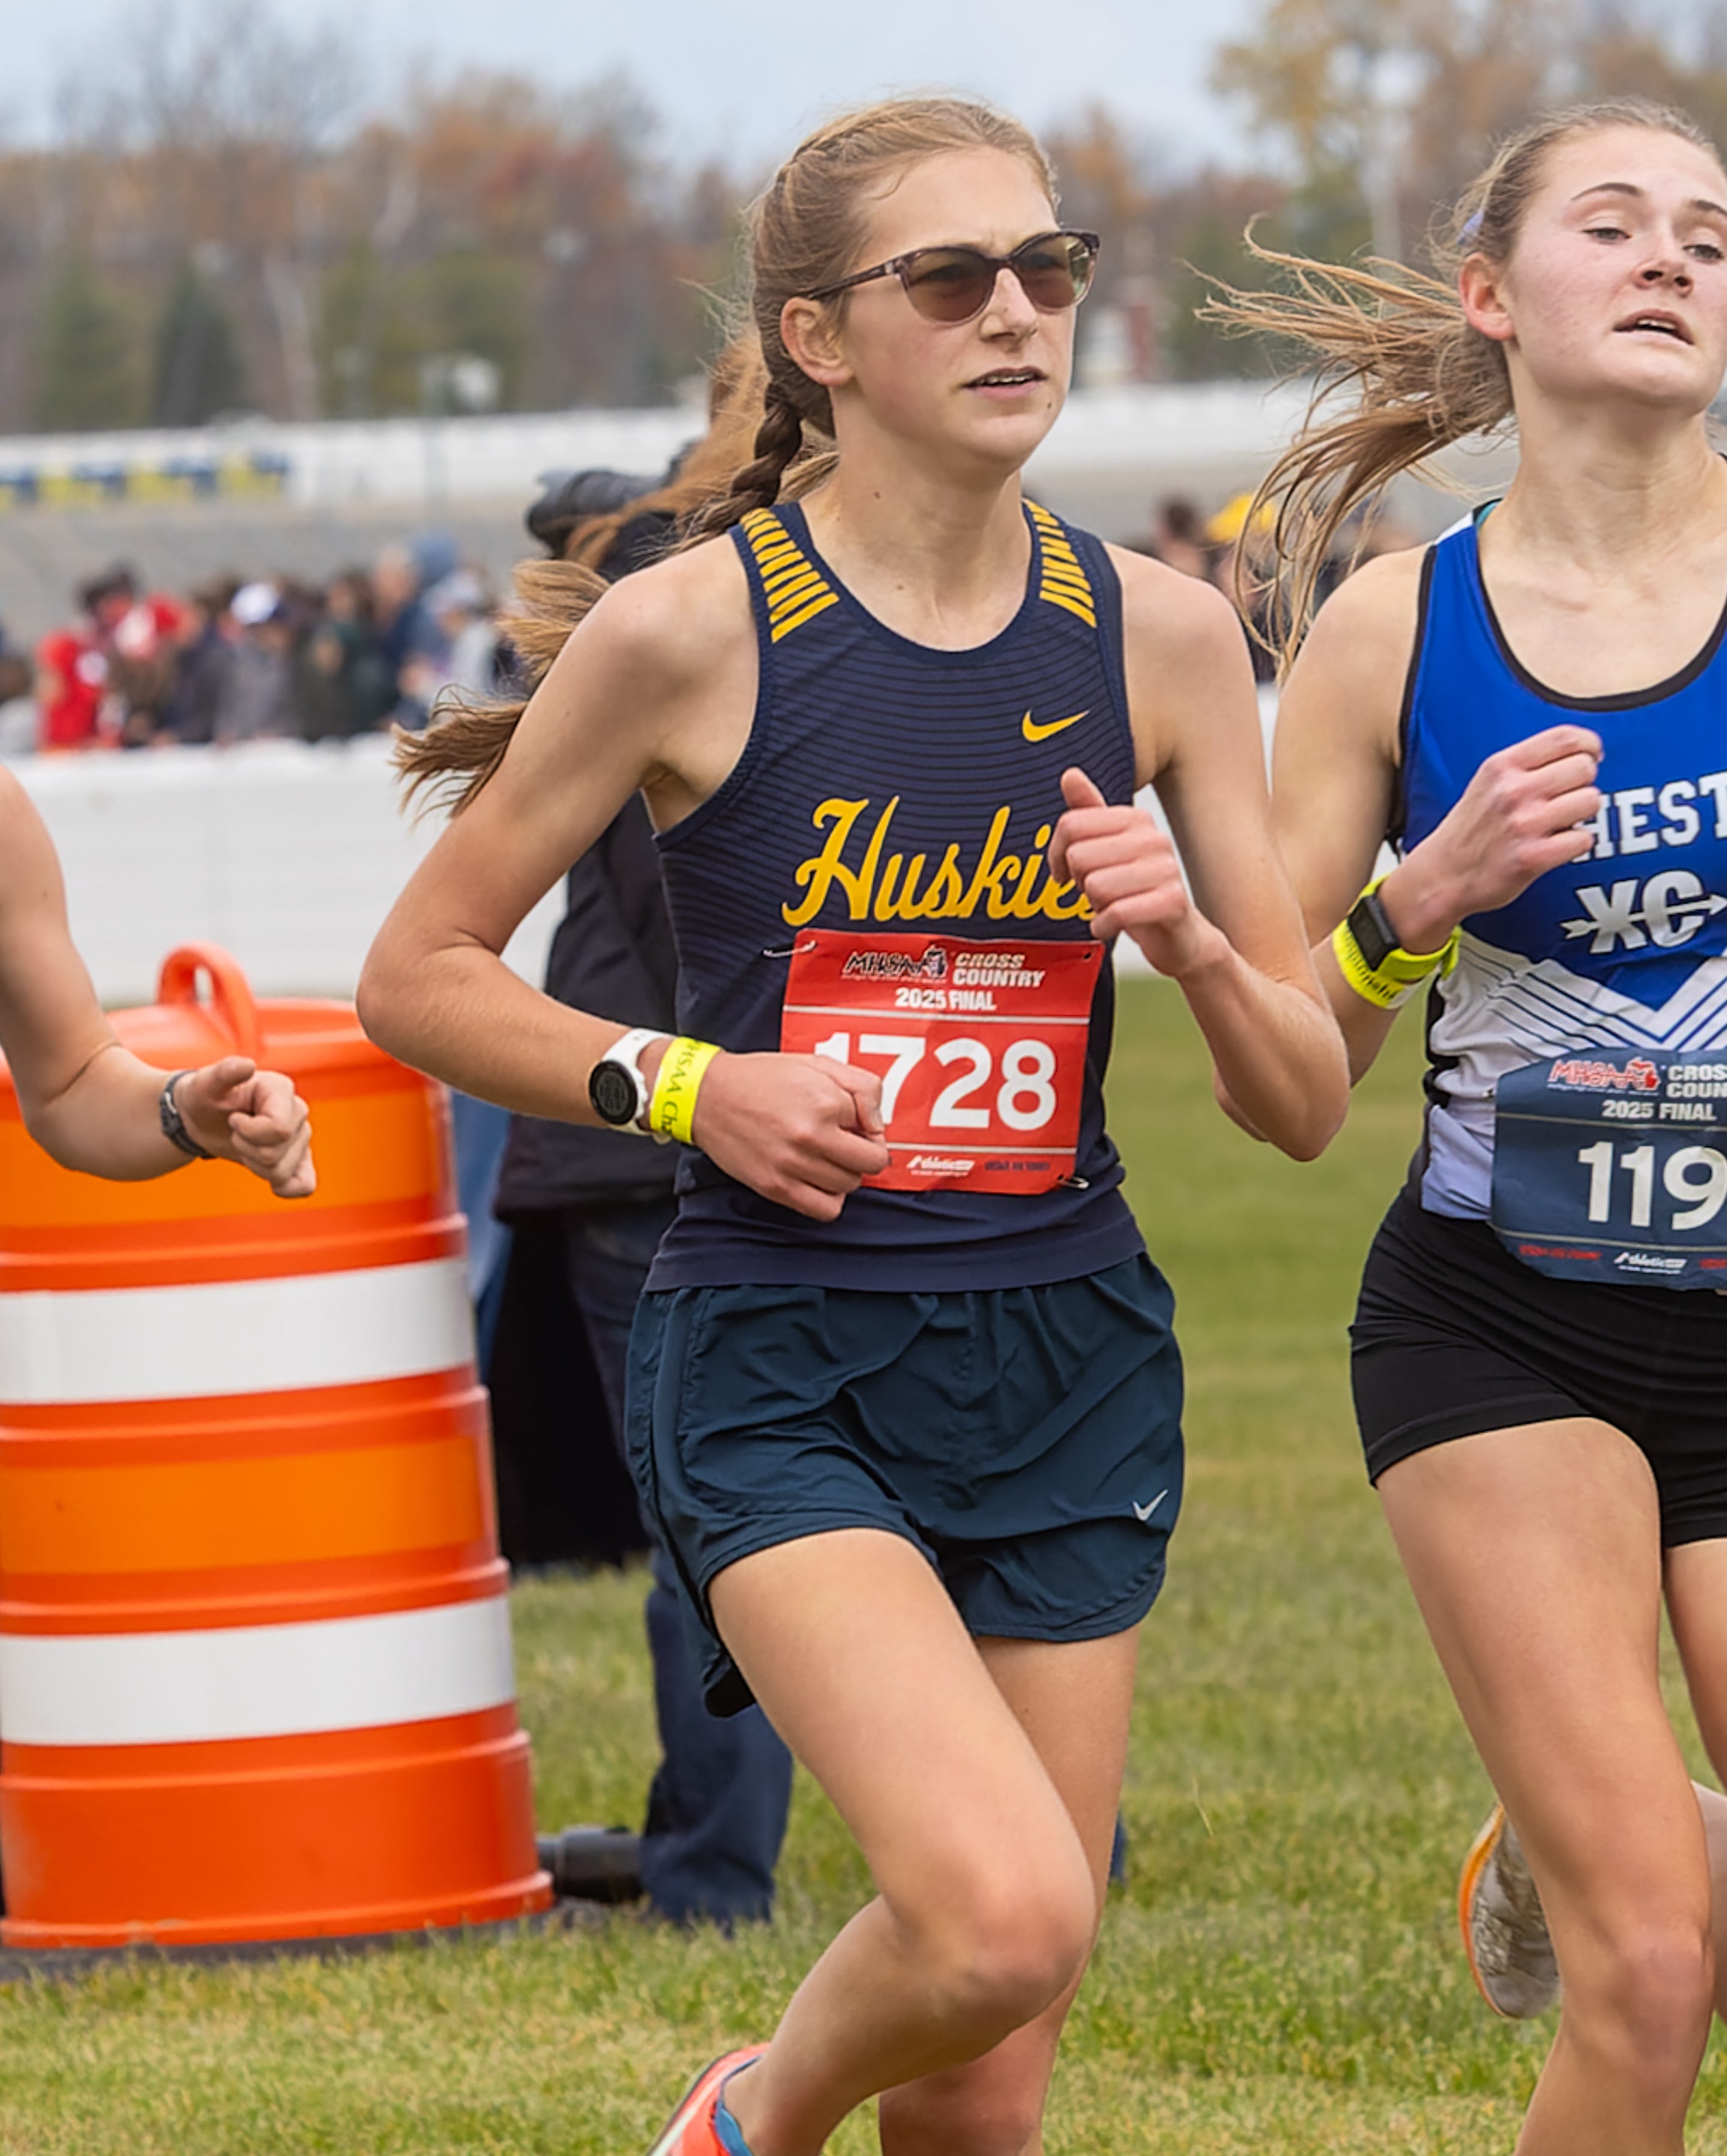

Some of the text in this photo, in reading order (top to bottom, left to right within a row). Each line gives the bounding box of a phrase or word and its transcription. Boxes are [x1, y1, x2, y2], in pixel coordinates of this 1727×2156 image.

[1575, 870, 1707, 954] XC
[955, 953, 1025, 968] CROSS
[953, 968, 1046, 988] COUNTRY
[895, 987, 997, 1011] 2025 FINAL
[1601, 1100, 1718, 1121] 2025 FINAL
[1578, 1141, 1727, 1230] 119
